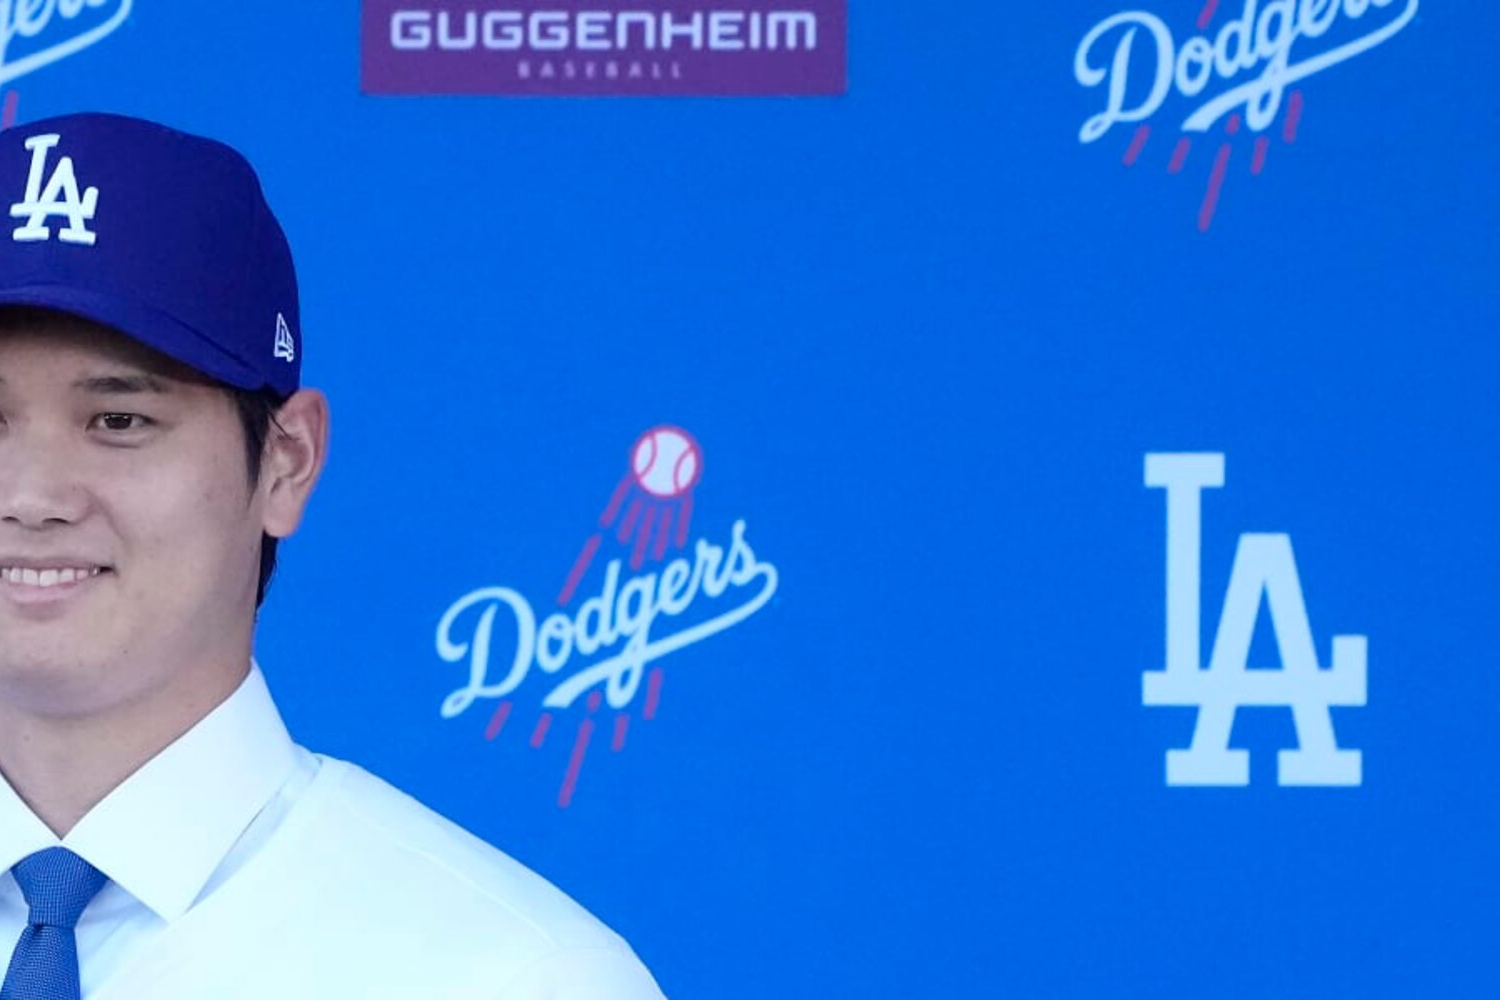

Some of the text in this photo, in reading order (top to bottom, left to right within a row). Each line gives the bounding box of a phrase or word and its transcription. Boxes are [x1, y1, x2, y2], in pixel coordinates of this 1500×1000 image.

[389, 9, 818, 51] GUGGENHEIM
[517, 60, 681, 80] BASEBALL
[1074, 0, 1419, 143] Dodge
[9, 133, 99, 246] LA
[436, 519, 778, 718] Dodgers
[1141, 452, 1368, 787] LA
